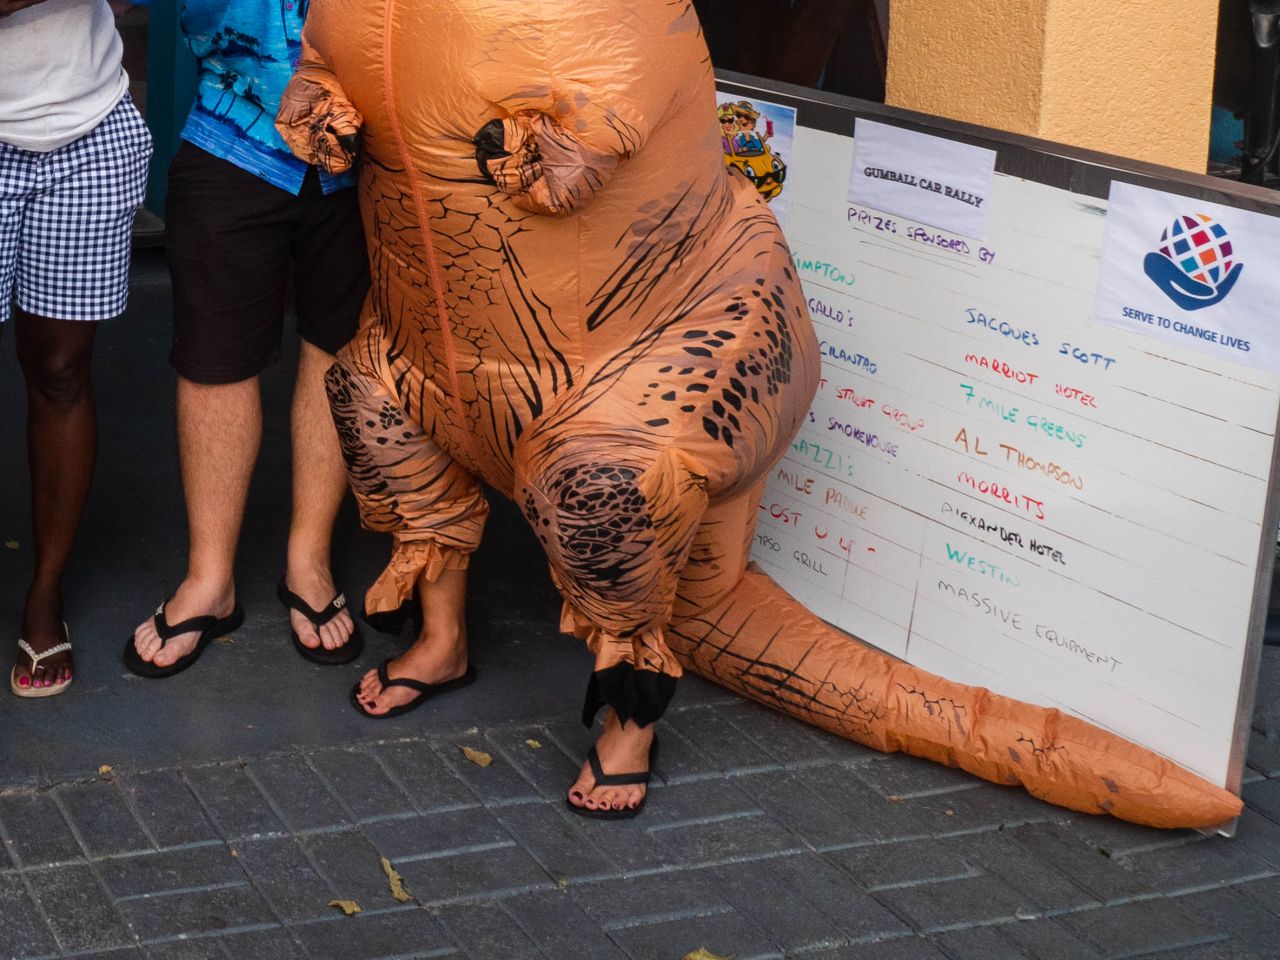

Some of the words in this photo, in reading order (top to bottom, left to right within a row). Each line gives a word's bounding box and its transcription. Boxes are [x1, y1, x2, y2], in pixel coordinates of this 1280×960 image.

[864, 167, 917, 187] GUMBALL
[919, 178, 942, 194] CAR
[944, 186, 983, 208] RALLY
[847, 207, 897, 233] PRIZES
[907, 226, 970, 254] SPONSORED
[978, 247, 995, 264] BY
[964, 308, 1040, 346] JACQUES
[1058, 342, 1117, 371] SCOTT
[1122, 306, 1154, 325] SERVE
[1157, 316, 1171, 329] TO
[1172, 321, 1218, 343] CHANGE
[1220, 334, 1250, 352] LIVES
[820, 341, 878, 374] CILANTRO
[964, 353, 1039, 386] MARRIOT
[827, 417, 900, 458] SMOKEHOUSE
[959, 383, 976, 404] 7
[978, 397, 1020, 424] MILE
[1026, 414, 1087, 449] GREENS
[777, 468, 815, 495] MILE
[954, 427, 988, 456] AL
[999, 443, 1084, 491] THOMPSON
[957, 471, 1045, 520] MORRITS
[793, 550, 829, 577] GRILL
[945, 542, 1020, 587] WESTIN
[1029, 538, 1067, 566] HOTEL
[938, 580, 1022, 630] MASSIVE
[1035, 624, 1123, 673] EQUIPMENT
